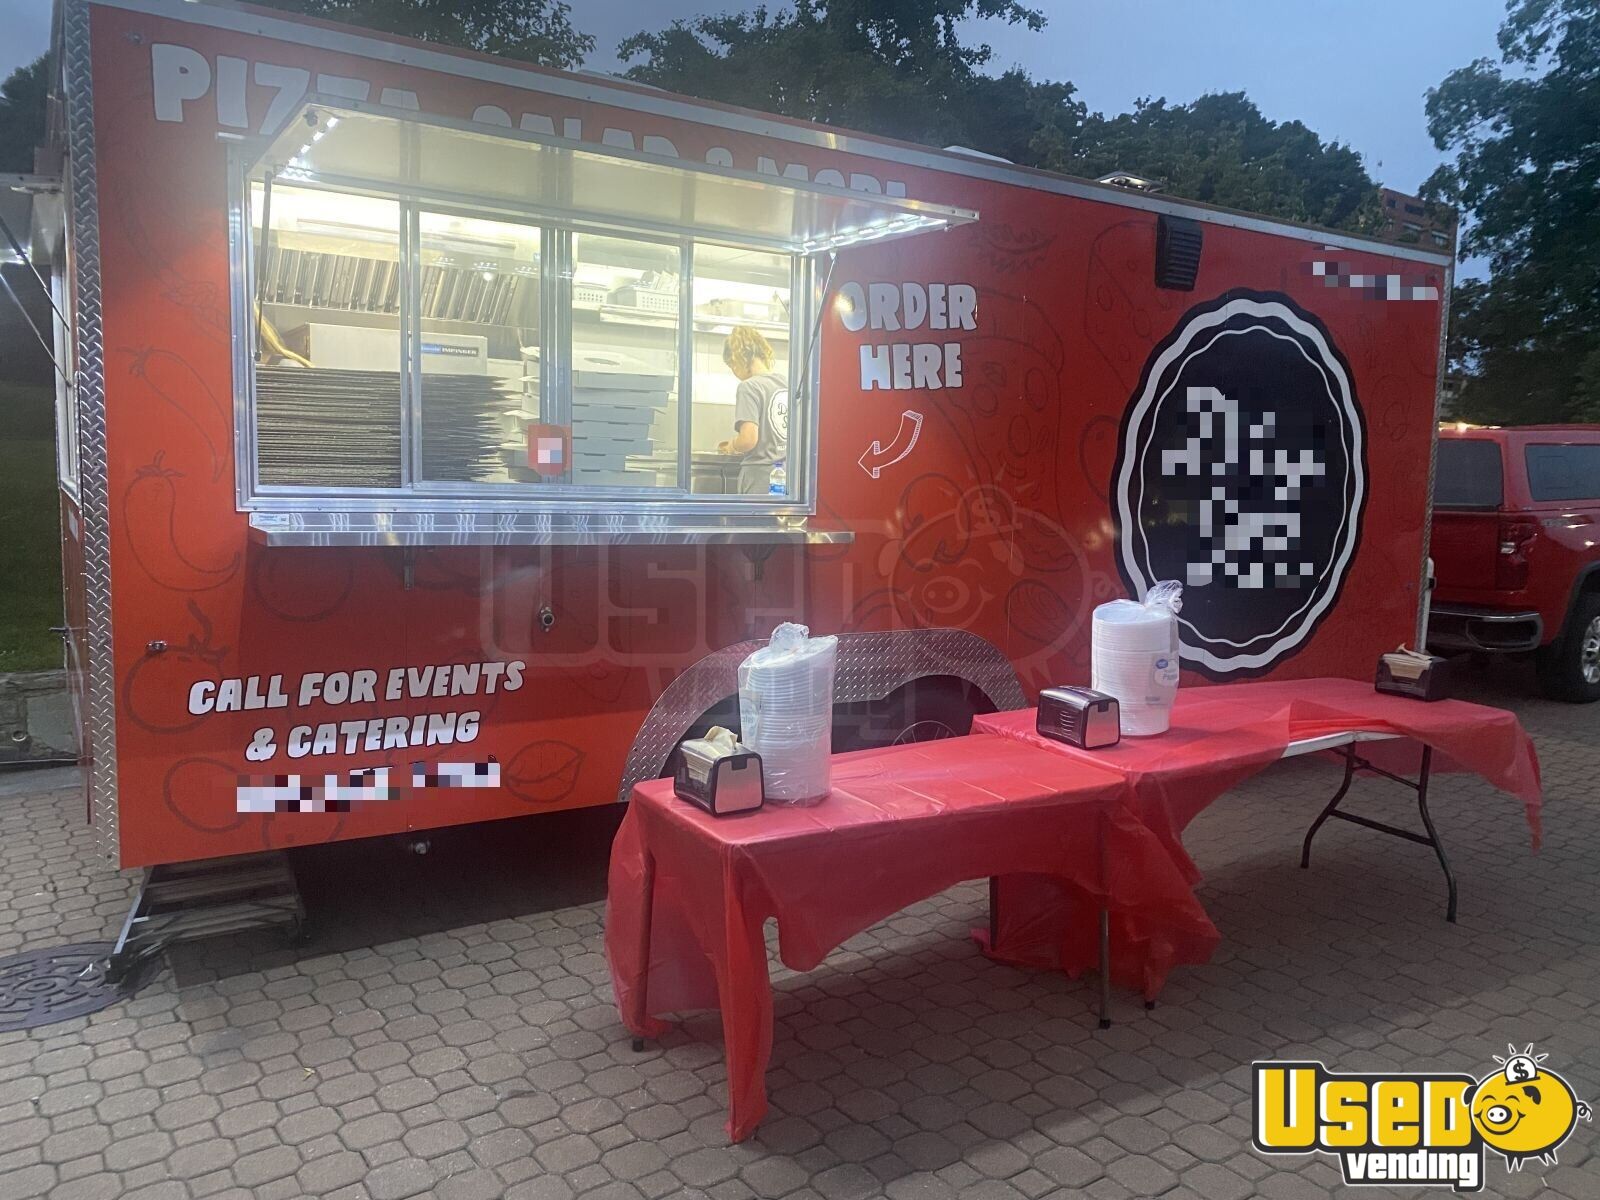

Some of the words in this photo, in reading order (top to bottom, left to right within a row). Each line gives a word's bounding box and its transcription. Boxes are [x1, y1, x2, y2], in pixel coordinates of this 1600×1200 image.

[151, 43, 420, 135] PIZ
[838, 281, 978, 332] ORDER
[859, 342, 963, 390] HERE
[188, 674, 289, 715] CALL
[298, 669, 378, 706] FOR
[385, 660, 527, 701] EVENTS
[245, 727, 277, 762] &
[287, 710, 481, 758] CATERING
